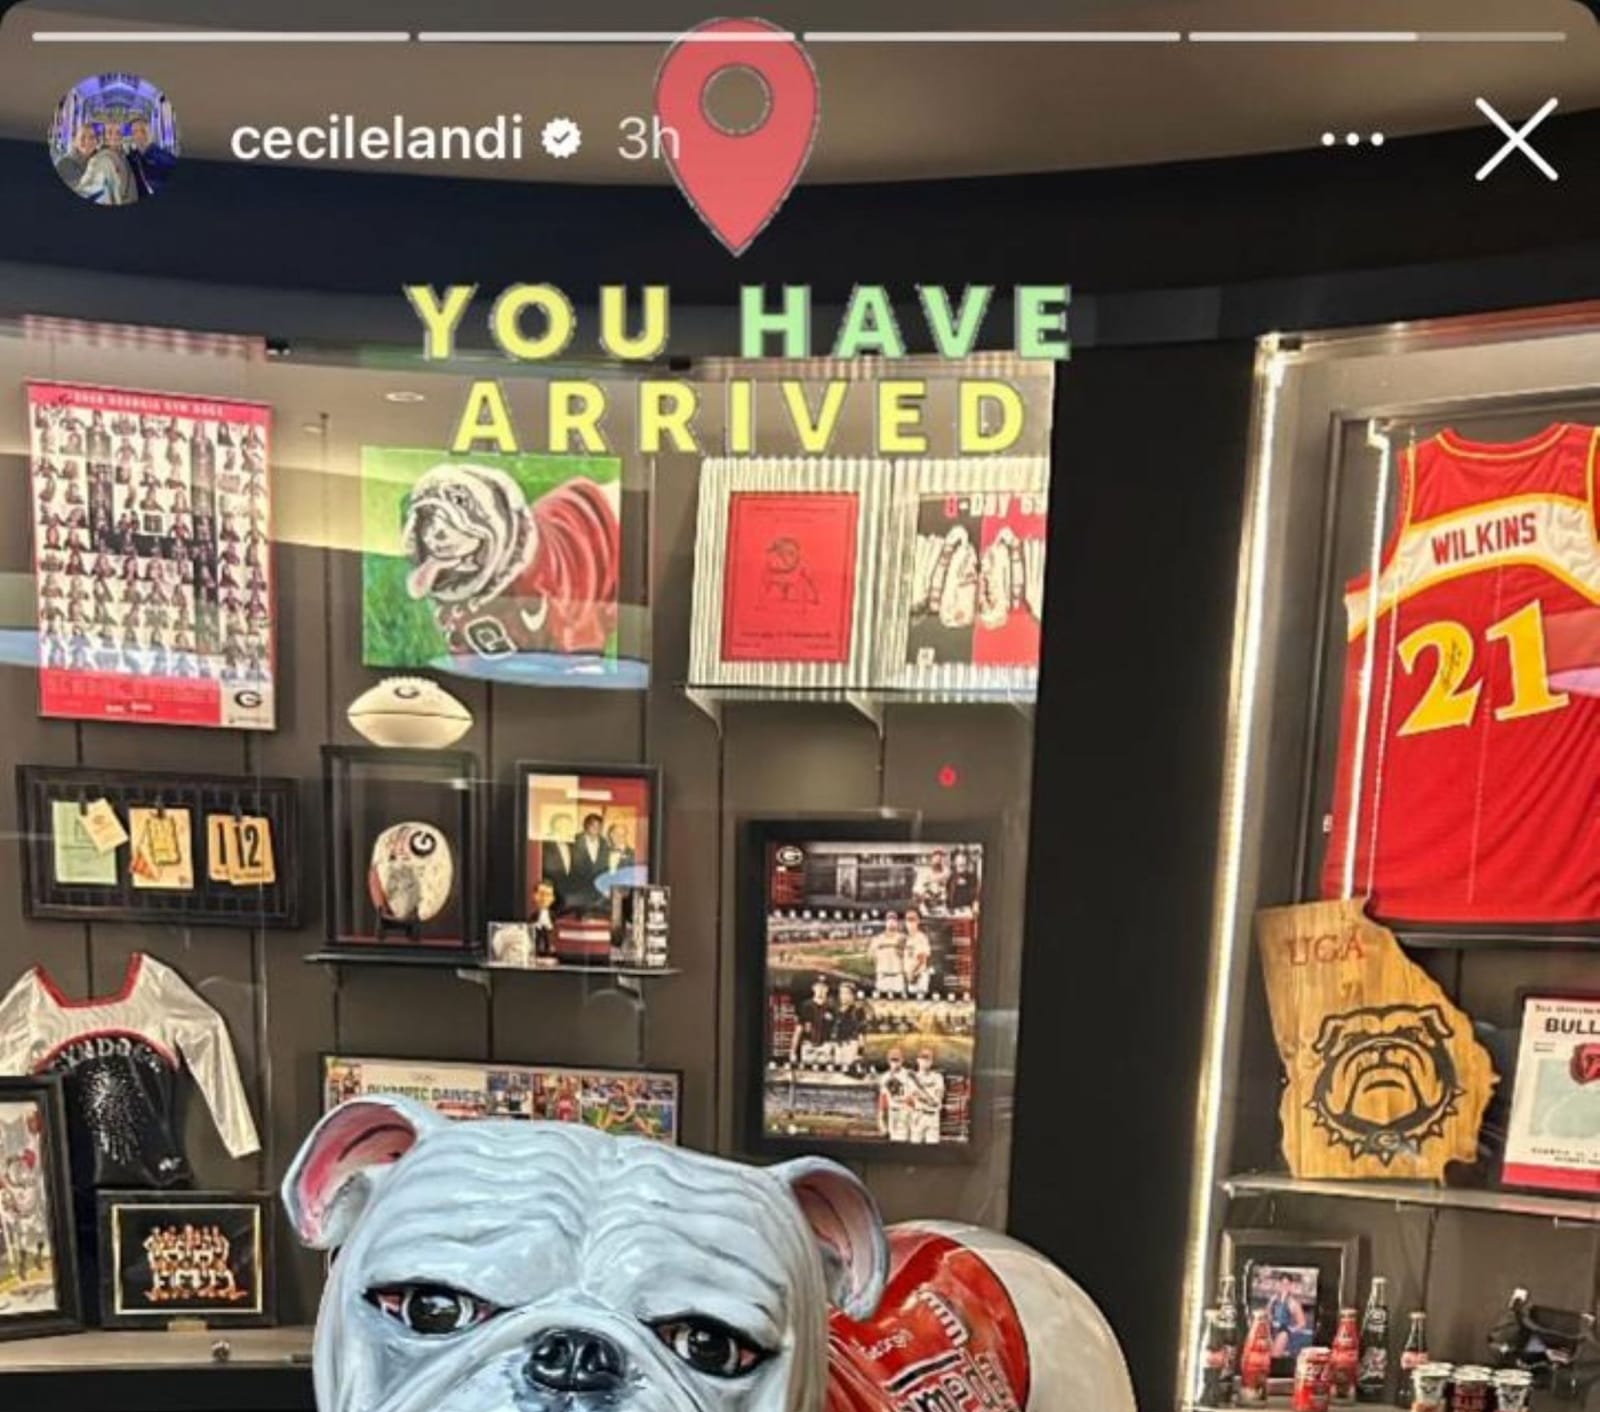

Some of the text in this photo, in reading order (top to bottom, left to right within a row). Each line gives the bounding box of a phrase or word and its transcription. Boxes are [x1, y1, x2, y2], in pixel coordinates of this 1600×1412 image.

[1432, 513, 1537, 566] WILKINS
[1396, 598, 1570, 737] 21
[233, 824, 262, 869] 12
[409, 831, 437, 858] G
[1287, 928, 1364, 966] UGA
